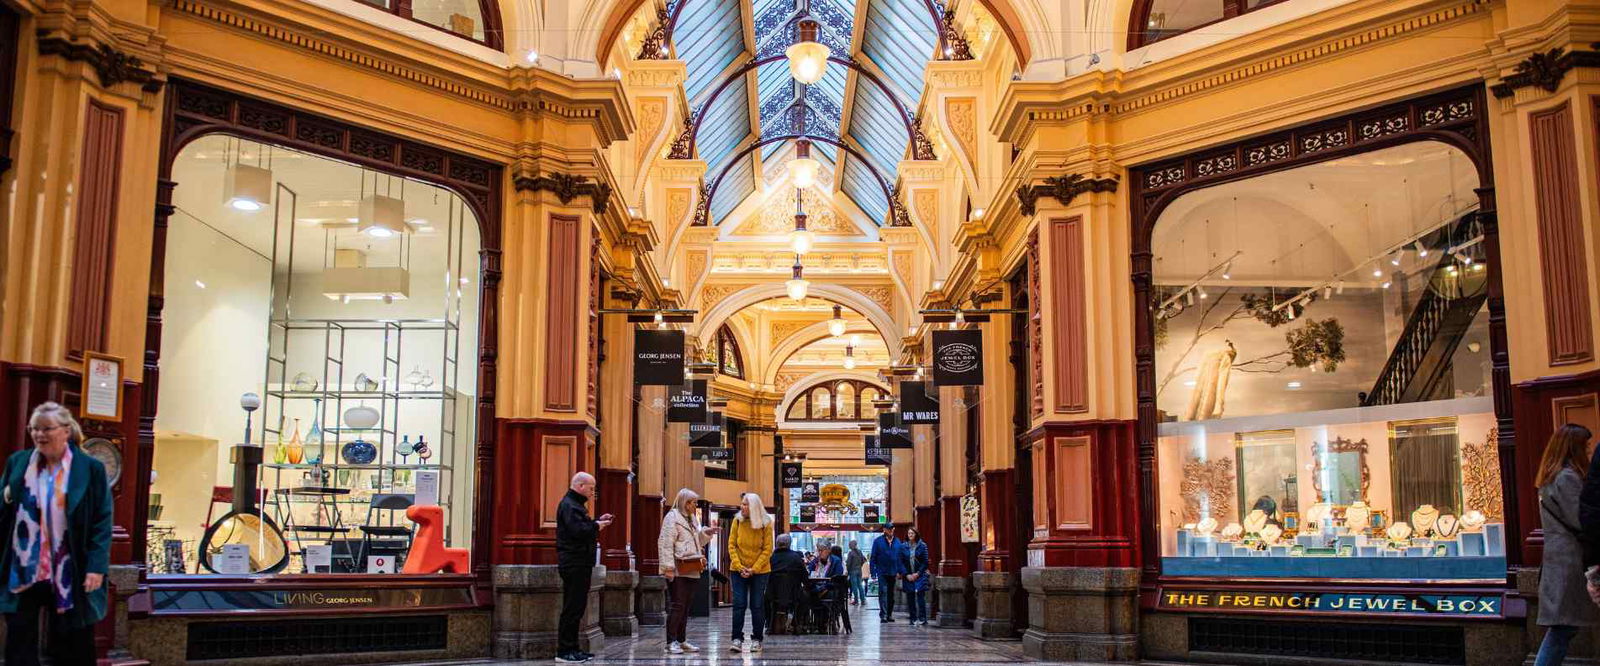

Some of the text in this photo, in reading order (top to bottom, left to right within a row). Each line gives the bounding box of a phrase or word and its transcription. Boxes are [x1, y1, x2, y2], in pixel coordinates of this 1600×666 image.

[903, 411, 938, 420] MR WARES
[274, 592, 325, 605] LIVING
[1166, 593, 1496, 613] THE FRENCH JEWEL BOX
